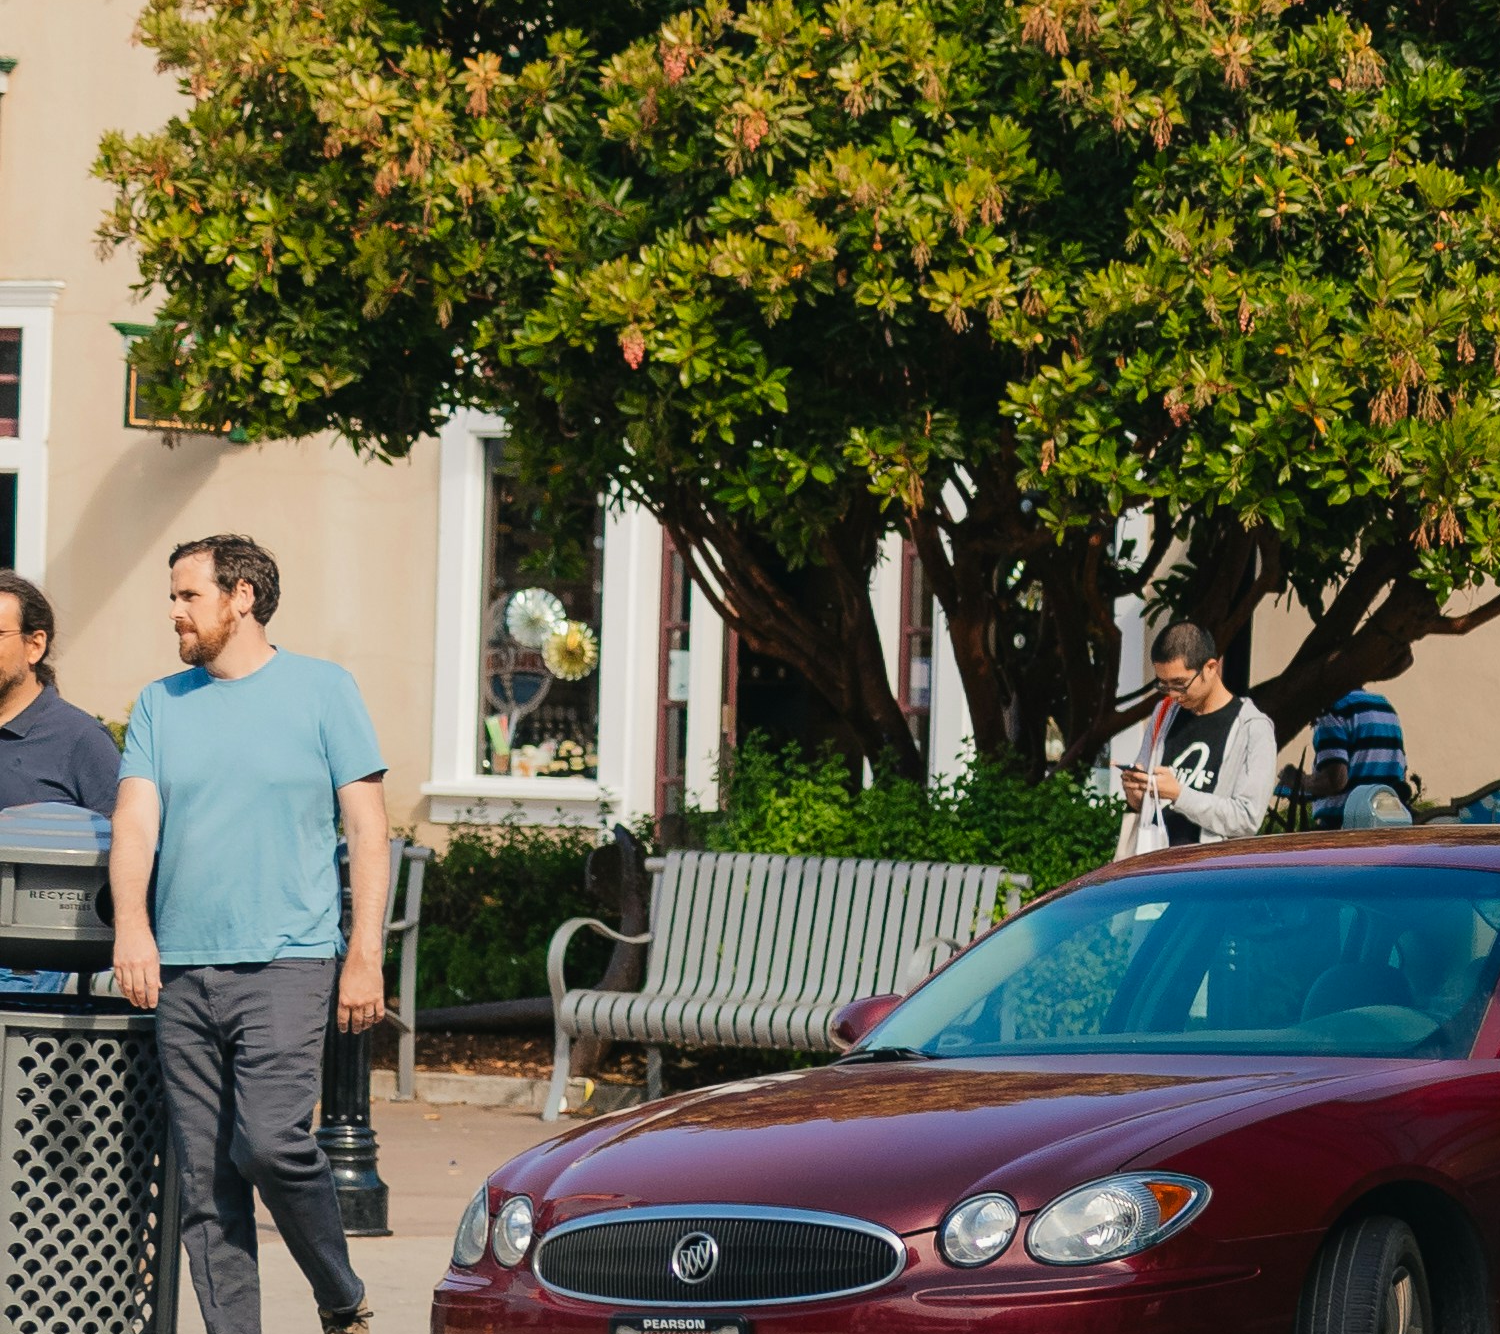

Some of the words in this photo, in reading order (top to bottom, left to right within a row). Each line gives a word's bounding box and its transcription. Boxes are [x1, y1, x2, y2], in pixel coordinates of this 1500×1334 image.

[29, 890, 92, 902] RECYCLE
[59, 903, 91, 911] BOTTLES
[643, 1319, 706, 1329] PEARSON
